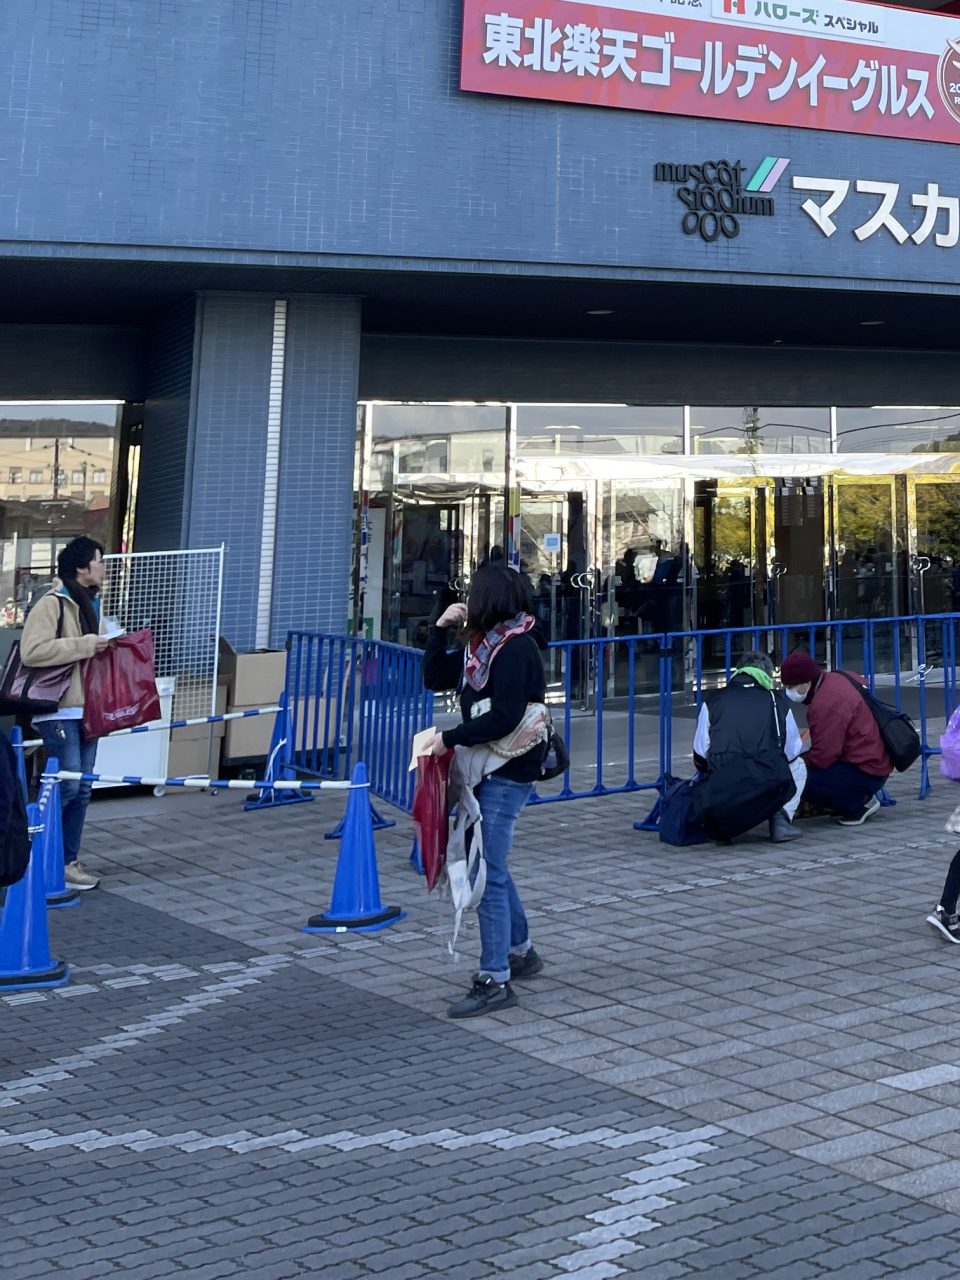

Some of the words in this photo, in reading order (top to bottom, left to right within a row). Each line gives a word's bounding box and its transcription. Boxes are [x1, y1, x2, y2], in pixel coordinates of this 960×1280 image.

[754, 0, 819, 25] ハローズ
[824, 14, 879, 34] スペシャル
[482, 13, 935, 120] 東北楽天ゴールデンイーグルス
